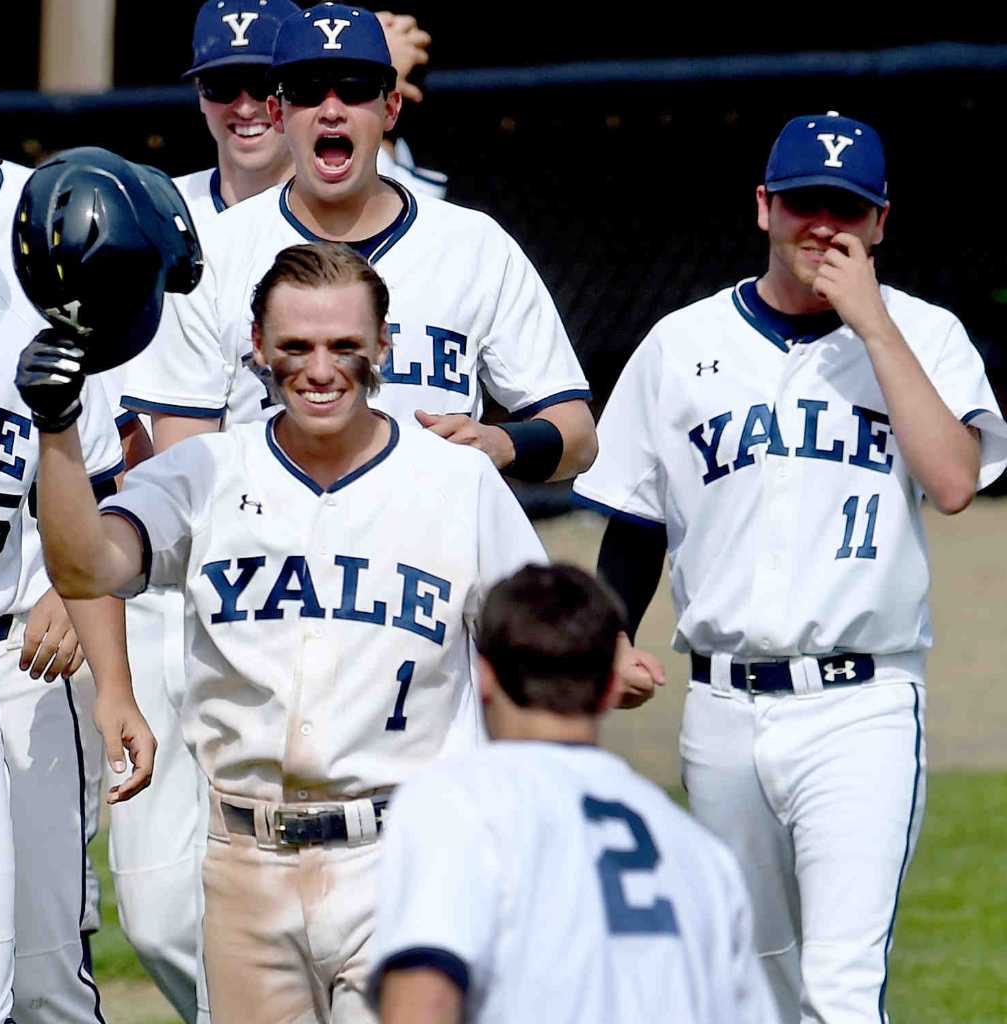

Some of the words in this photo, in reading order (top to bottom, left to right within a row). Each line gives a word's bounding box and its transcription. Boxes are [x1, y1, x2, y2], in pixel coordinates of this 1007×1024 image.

[222, 12, 258, 46] Y
[313, 18, 350, 49] Y
[818, 133, 853, 168] Y
[689, 399, 894, 485] YALE
[835, 493, 880, 560] 11
[201, 555, 451, 646] YALE
[385, 660, 415, 732] 1
[582, 794, 678, 935] 2
